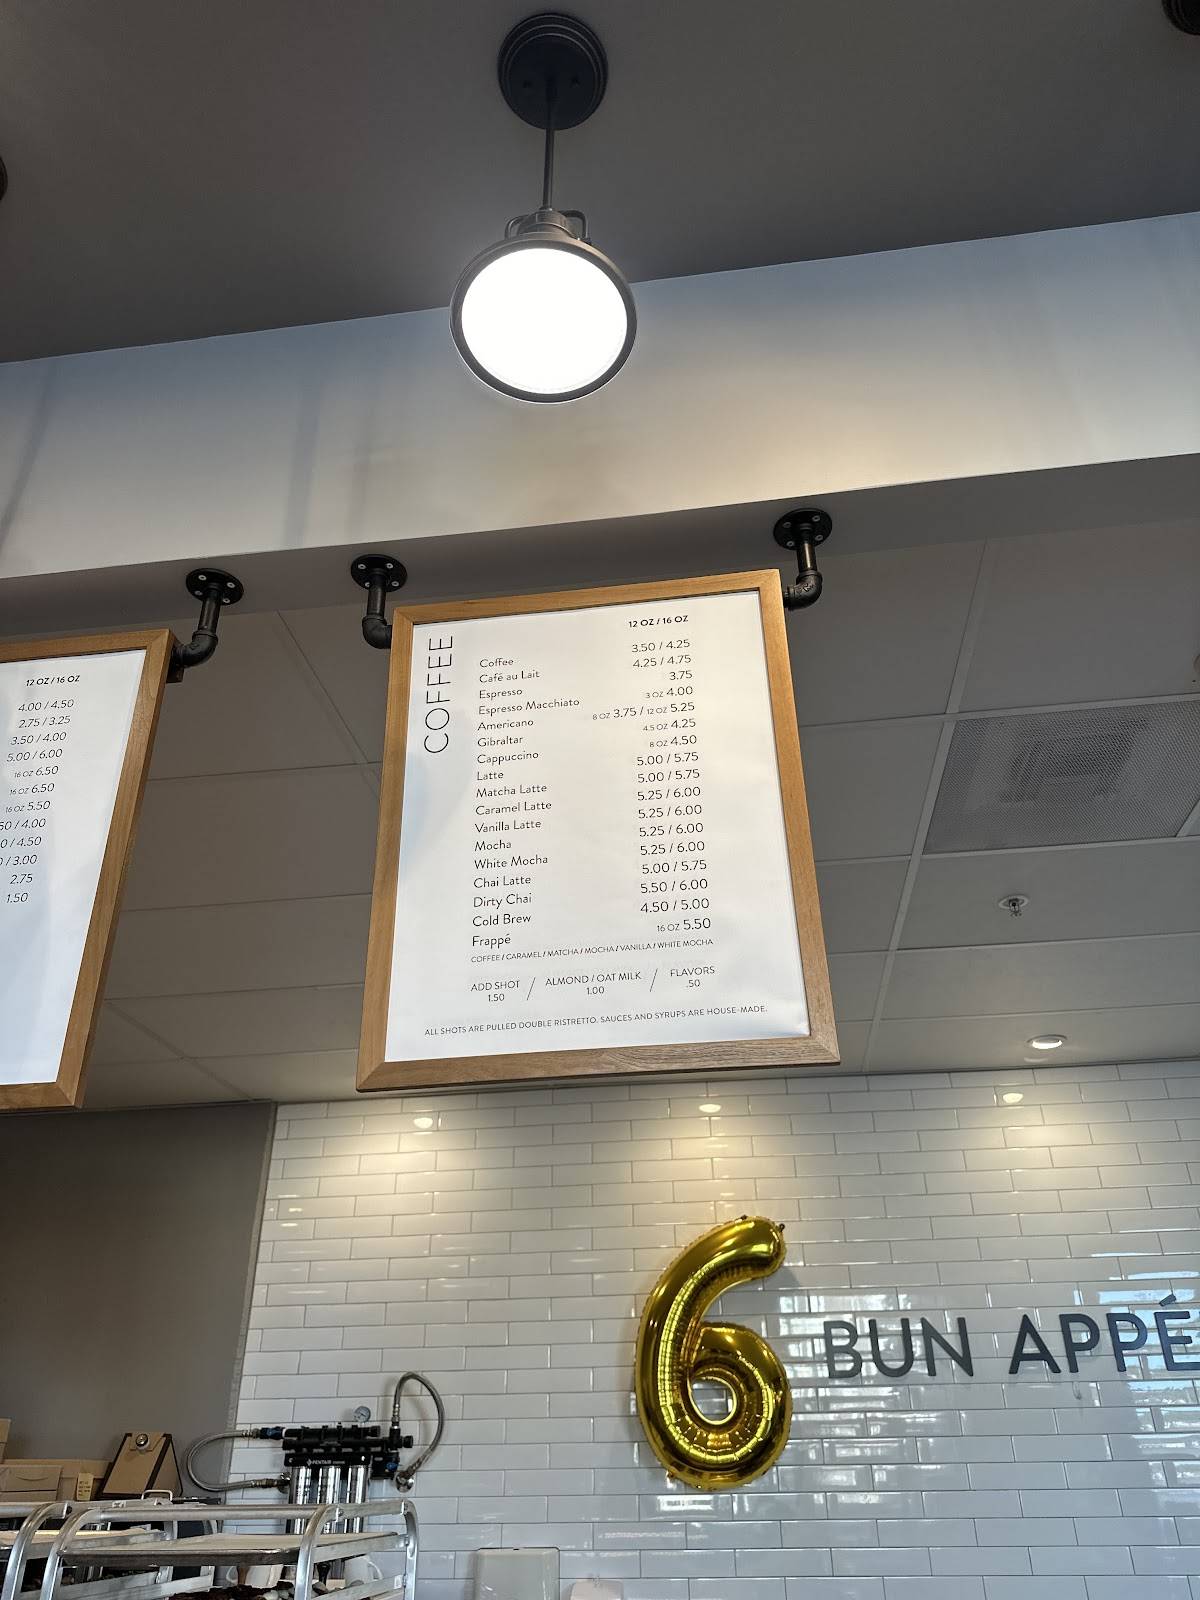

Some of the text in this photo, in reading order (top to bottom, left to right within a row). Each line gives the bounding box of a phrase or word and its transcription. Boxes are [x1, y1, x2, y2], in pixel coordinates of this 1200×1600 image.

[632, 643, 655, 652] 3.50
[666, 639, 690, 648] 4.25
[480, 658, 513, 667] Coffee
[633, 658, 656, 667] 4.25
[667, 655, 691, 664] 4.75
[480, 673, 503, 683] Café
[522, 670, 539, 679] Lait
[669, 670, 692, 680] 3.75
[424, 635, 453, 753] COFFEE
[480, 690, 522, 700] Espresso
[667, 686, 693, 696] 4.00
[18, 702, 41, 711] 4.00
[51, 699, 74, 708] 4.50
[479, 698, 579, 717] Espresso Macchiato
[614, 708, 636, 718] 3.75
[671, 702, 694, 712] 5.25
[19, 718, 40, 728] 2.75
[49, 716, 70, 725] 3.25
[477, 720, 533, 731] Americano
[671, 718, 696, 728] 4.25
[11, 735, 34, 745] 3.50
[43, 732, 66, 741] 4.00
[478, 736, 523, 747] Gibraltar
[671, 735, 696, 745] 4.50
[7, 752, 30, 762] 5.00
[39, 749, 62, 759] 6.00
[477, 751, 538, 766] Cappuccino
[637, 755, 663, 765] 5.00
[675, 752, 698, 762] 5.75
[36, 766, 58, 776] 6.50
[477, 771, 504, 780] Latte
[638, 772, 664, 783] 5.00
[676, 769, 699, 779] 5.75
[32, 783, 54, 793] 6.50
[476, 785, 547, 797] Matcha Latte
[638, 790, 662, 801] 5.25
[674, 787, 700, 797] 6.00
[27, 801, 50, 811] 5.50
[476, 802, 551, 815] Caramel Latte
[639, 808, 663, 819] 5.25
[675, 805, 702, 815] 6.00
[21, 818, 46, 828] 4.00
[475, 820, 541, 832] Vanilla Latte
[640, 826, 664, 837] 5.25
[676, 823, 703, 834] 6.00
[17, 836, 41, 846] 4.50
[475, 840, 511, 851] Mocha
[641, 844, 665, 855] 5.25
[677, 841, 704, 852] 6.00
[13, 855, 37, 865] 3.00
[475, 855, 547, 869] White Mocha
[643, 863, 669, 874] 5.00
[682, 860, 706, 871] 5.75
[10, 874, 32, 884] 2.75
[474, 876, 531, 888] Chai Latte
[641, 882, 667, 893] 5.50
[680, 879, 707, 890] 6.00
[7, 893, 28, 903] 1.50
[474, 893, 531, 909] Dirty Chai
[641, 901, 668, 912] 4.50
[681, 898, 709, 910] 5.00
[473, 914, 531, 926] Cold Brew
[657, 918, 710, 932] 16 OZ 5.50
[473, 934, 511, 949] Frappé
[506, 952, 541, 960] CARAMEL
[585, 946, 614, 954] MOCHA
[620, 943, 652, 951] VANILLA
[683, 938, 713, 947] MOCHA
[671, 966, 715, 976] FLAVORS
[546, 976, 589, 986] ALMOND
[597, 973, 616, 982] OAT
[619, 972, 641, 980] MILK
[687, 979, 700, 987] .50
[471, 980, 520, 991] ADD SHOT
[587, 986, 604, 995] 1.00
[488, 994, 504, 1002] 1.50
[425, 1028, 439, 1036] ALL
[487, 1023, 516, 1031] PULLED
[519, 1020, 552, 1028] DOUBLE
[600, 1015, 632, 1023] SAUCES
[655, 1010, 686, 1019] SYRUPS
[634, 1215, 792, 1491] 6
[824, 1317, 974, 1379] BUN
